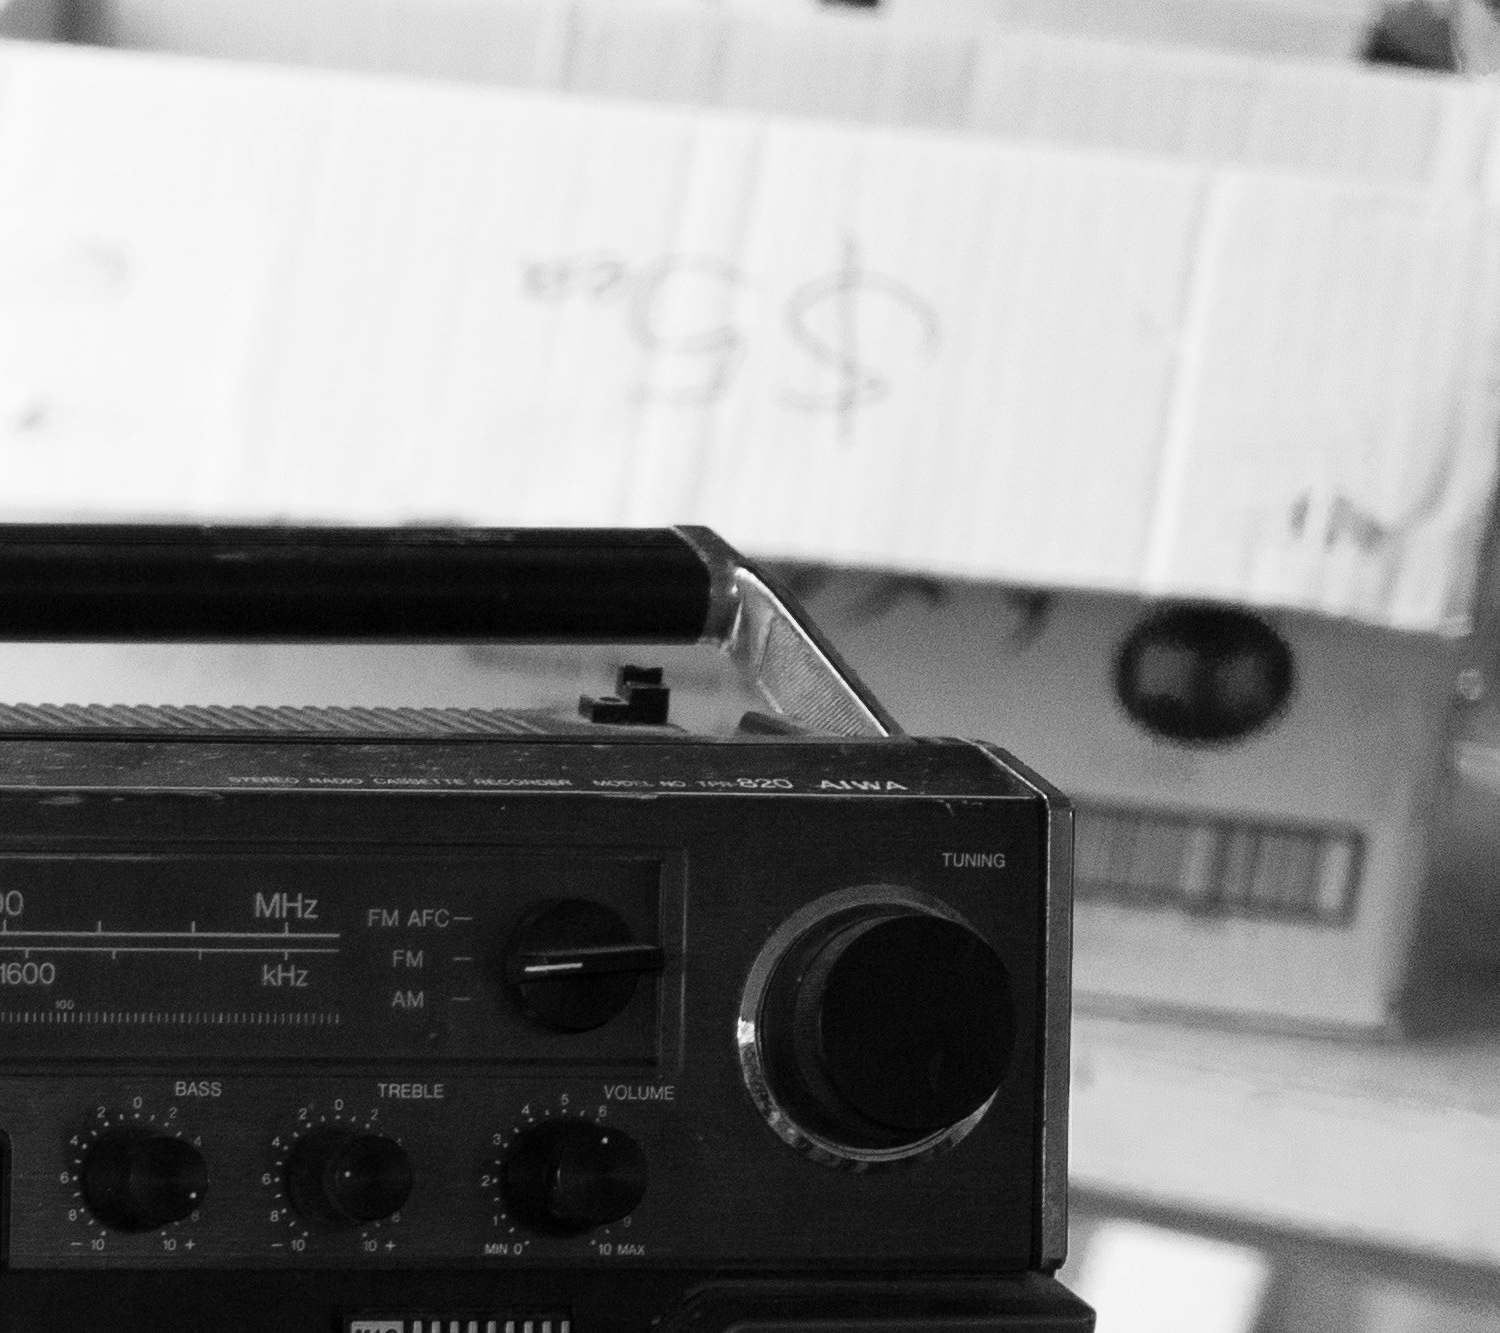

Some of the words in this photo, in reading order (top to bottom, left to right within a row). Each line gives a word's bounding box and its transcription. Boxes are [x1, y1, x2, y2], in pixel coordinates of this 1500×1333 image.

[227, 774, 300, 785] STEREO
[307, 775, 364, 786] RADIO
[371, 776, 467, 787] CASSETTE
[472, 777, 573, 788] RECORDER
[819, 779, 909, 791] AIWA
[941, 852, 1007, 869] TUNING
[254, 892, 319, 919] MHz
[367, 908, 399, 928] FM
[406, 908, 451, 929] AFC
[391, 949, 424, 969] FM
[261, 964, 309, 988] kHz
[391, 991, 425, 1009] AM
[174, 1080, 223, 1098] BASS
[377, 1083, 445, 1099] TREBLE
[603, 1085, 676, 1101] VOLUME
[132, 1096, 143, 1109] 0
[334, 1098, 344, 1111] 0
[560, 1094, 570, 1106] 5
[97, 1106, 106, 1119] 2
[168, 1106, 179, 1119] 2
[299, 1107, 308, 1120] 2
[370, 1108, 380, 1120] 2
[521, 1104, 531, 1116] 4
[598, 1105, 608, 1118] 6
[69, 1134, 80, 1146] 4
[271, 1136, 281, 1148] 4
[492, 1132, 502, 1146] 3
[59, 1172, 70, 1184] 6
[261, 1173, 272, 1185] 6
[480, 1174, 490, 1188] 2
[68, 1209, 78, 1221] 8
[269, 1210, 280, 1222] 8
[493, 1215, 499, 1226] 1
[484, 1242, 509, 1256] MIN
[513, 1242, 524, 1256] 0
[598, 1243, 612, 1256] 10
[616, 1243, 646, 1257] MAX
